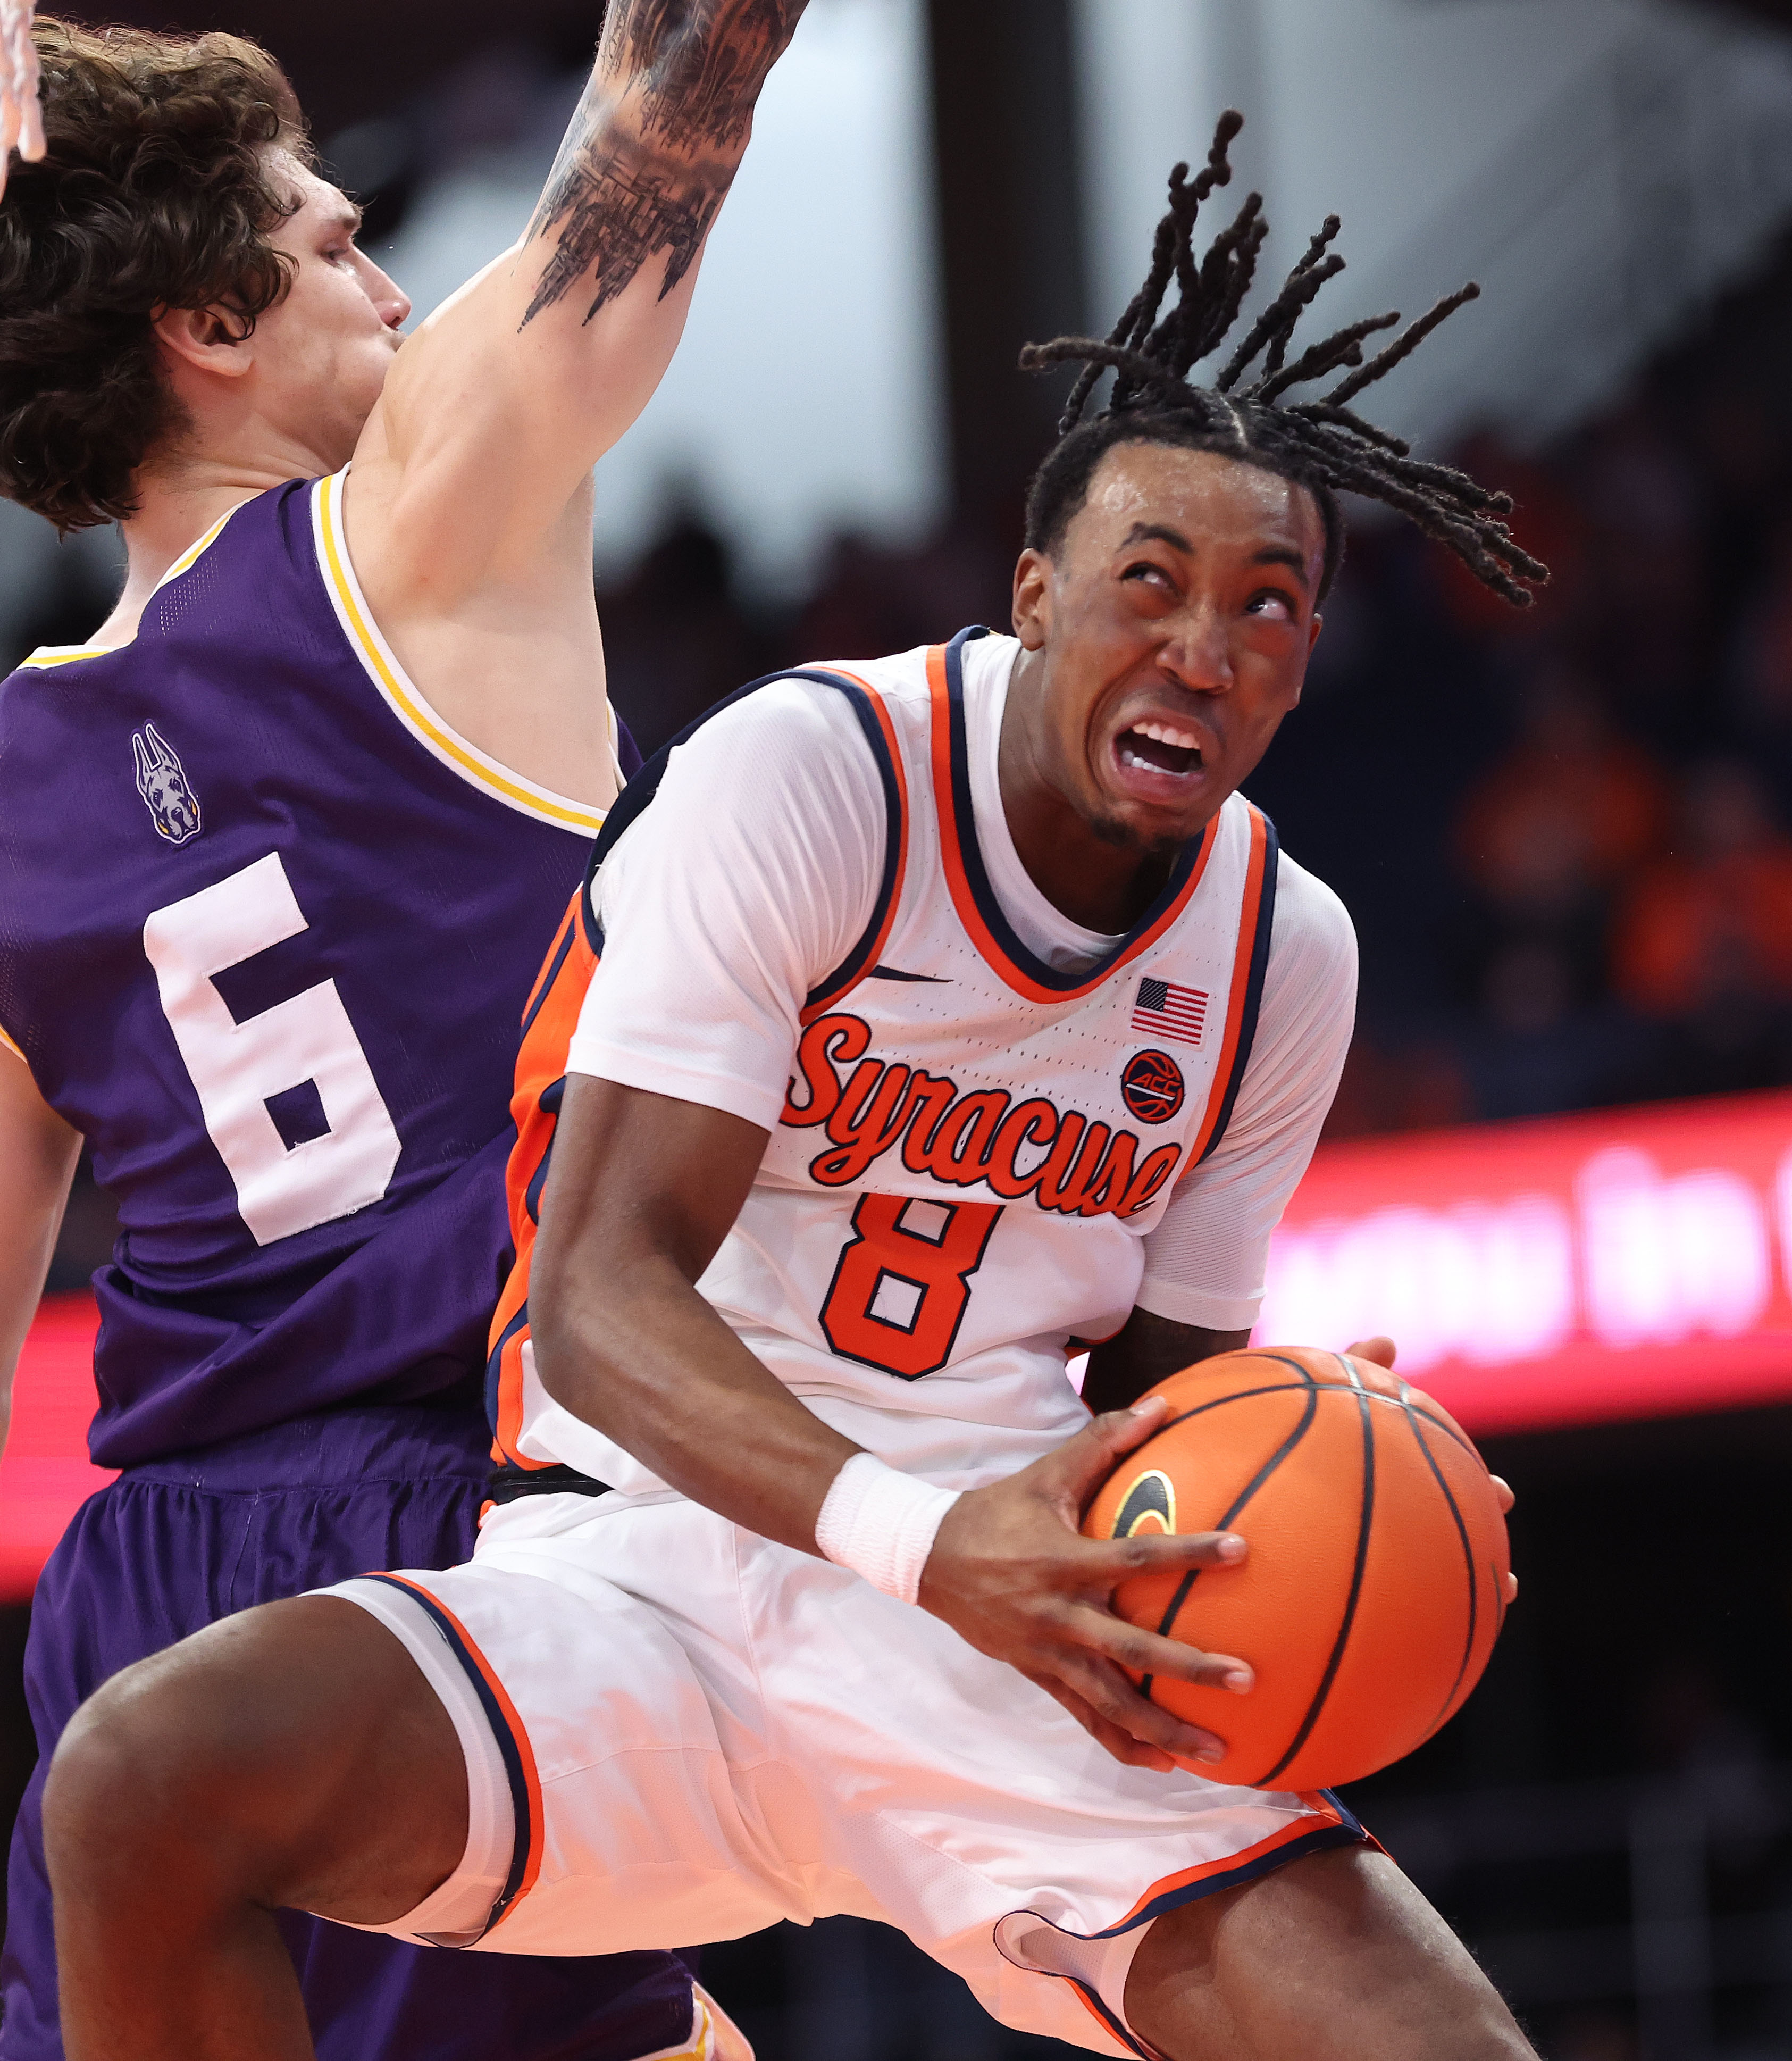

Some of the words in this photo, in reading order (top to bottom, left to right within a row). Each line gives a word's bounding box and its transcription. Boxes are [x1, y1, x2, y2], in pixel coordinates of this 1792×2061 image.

[143, 851, 403, 1246] 6
[778, 1013, 1183, 1218] Syracuse
[1131, 1073, 1182, 1097] ACC
[818, 1192, 1006, 1381] 8
